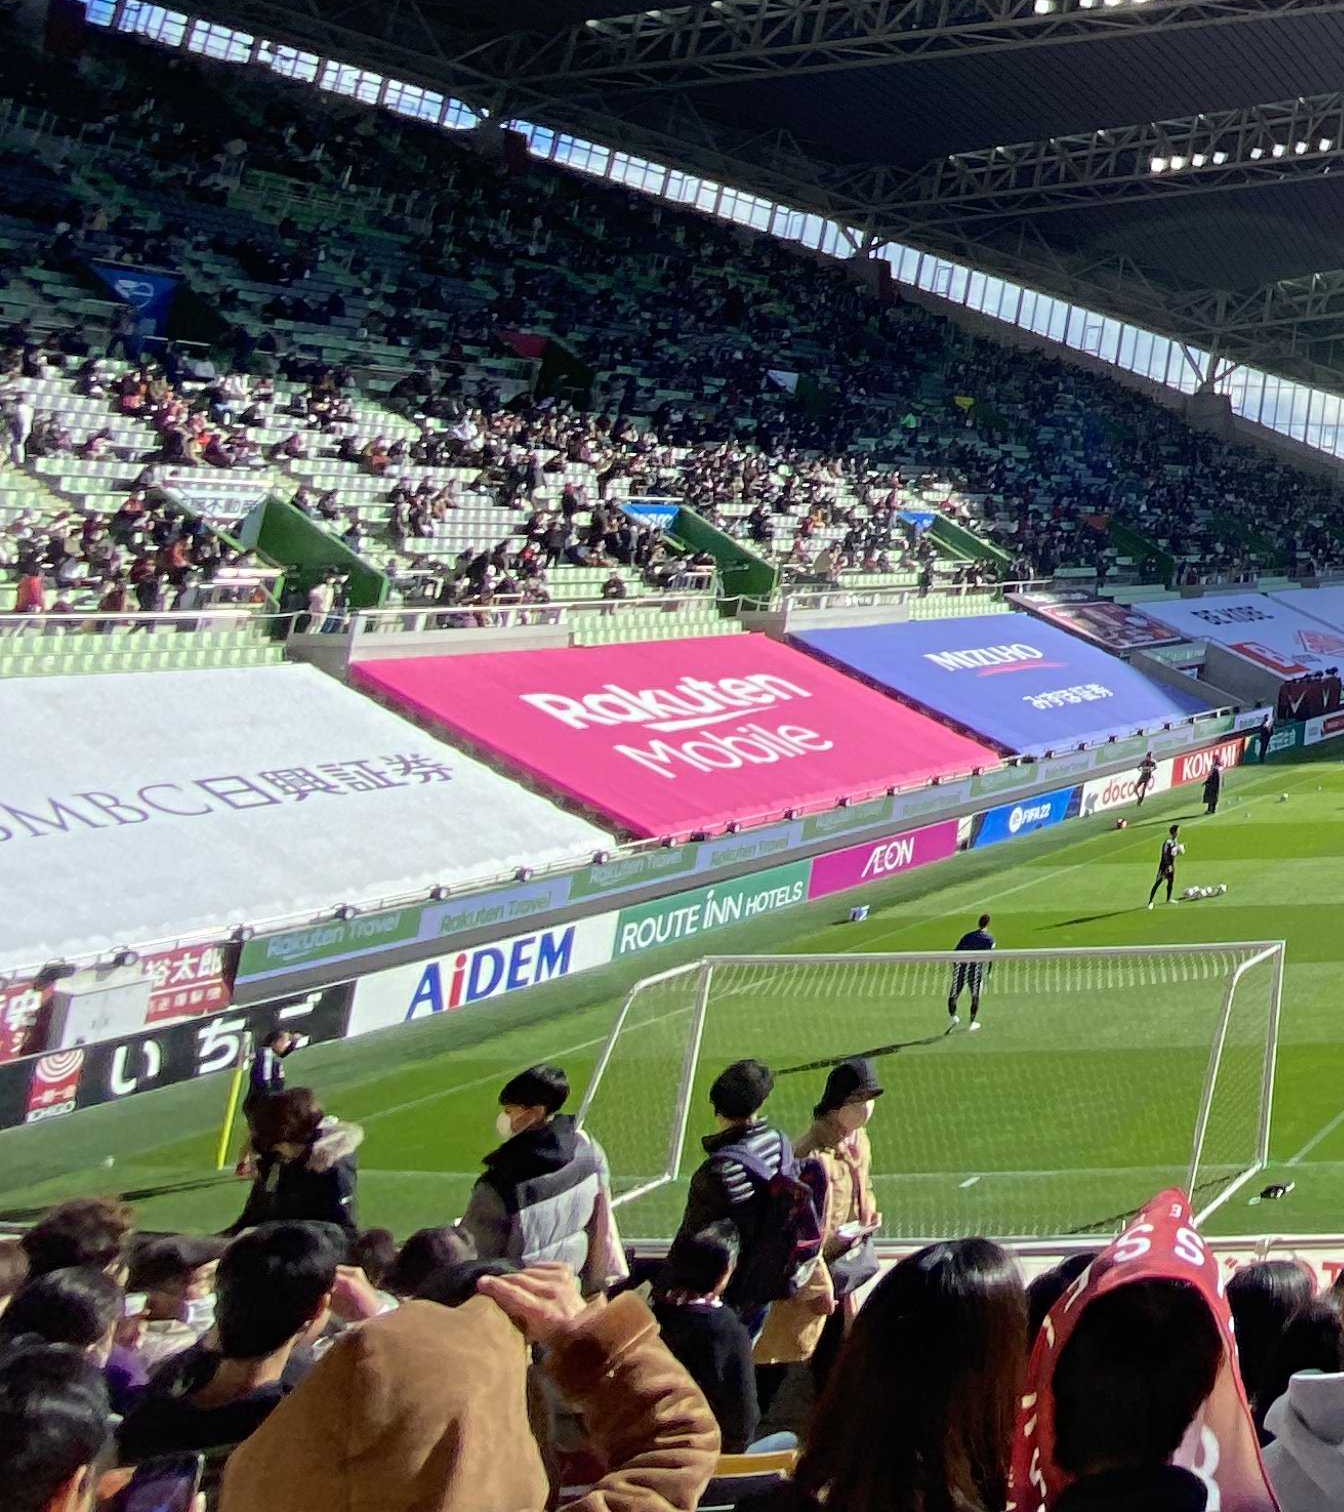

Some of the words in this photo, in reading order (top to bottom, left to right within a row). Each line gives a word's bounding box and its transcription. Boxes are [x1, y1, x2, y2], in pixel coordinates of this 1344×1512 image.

[922, 643, 1044, 672] MIZUHO
[519, 674, 813, 730] Rakuten
[612, 722, 834, 779] Mobile
[1102, 775, 1155, 805] docoo
[267, 926, 344, 959] Rakuten
[349, 915, 400, 939] Travel
[620, 904, 700, 954] ROUTE
[745, 881, 803, 916] HOTELS
